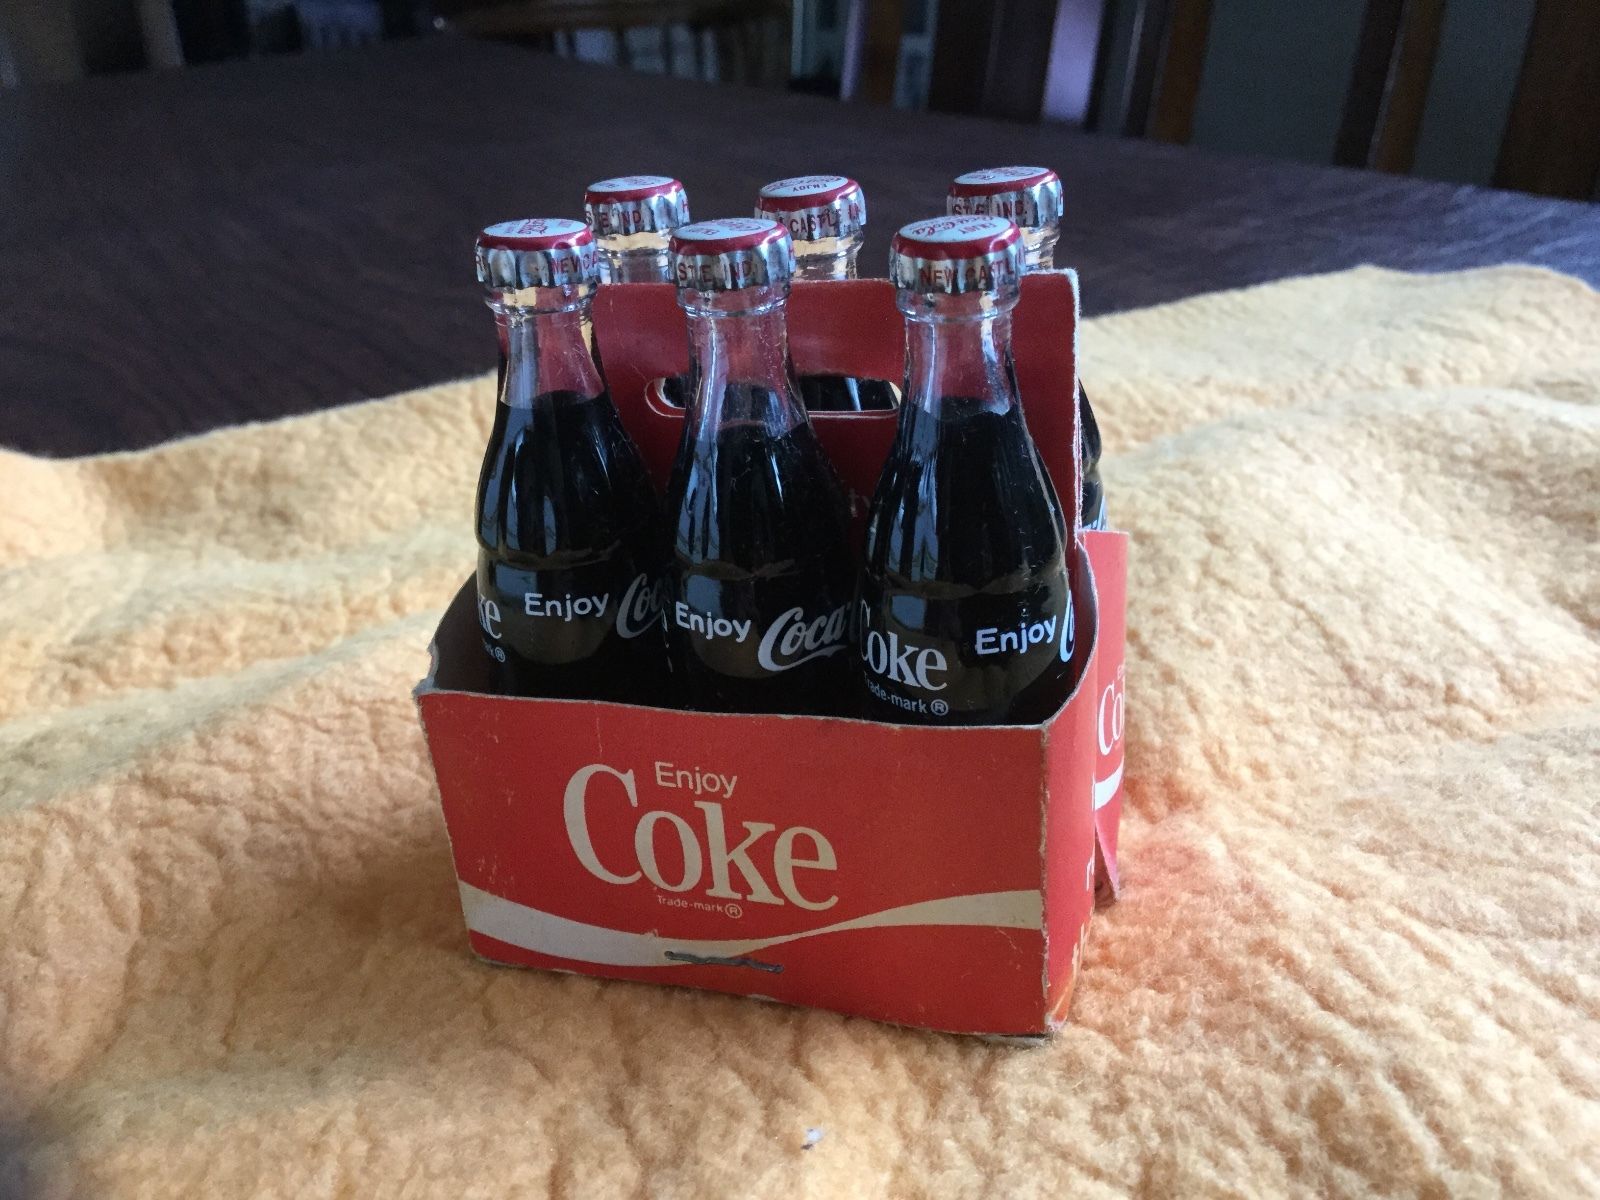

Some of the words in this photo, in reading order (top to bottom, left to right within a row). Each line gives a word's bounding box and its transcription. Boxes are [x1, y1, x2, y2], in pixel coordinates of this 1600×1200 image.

[524, 592, 609, 622] Enjoy
[675, 601, 752, 642] Enjoy
[861, 599, 948, 691] Coke
[975, 615, 1057, 656] Enjoy
[655, 761, 738, 799] Enjoy
[563, 763, 840, 912] Coke
